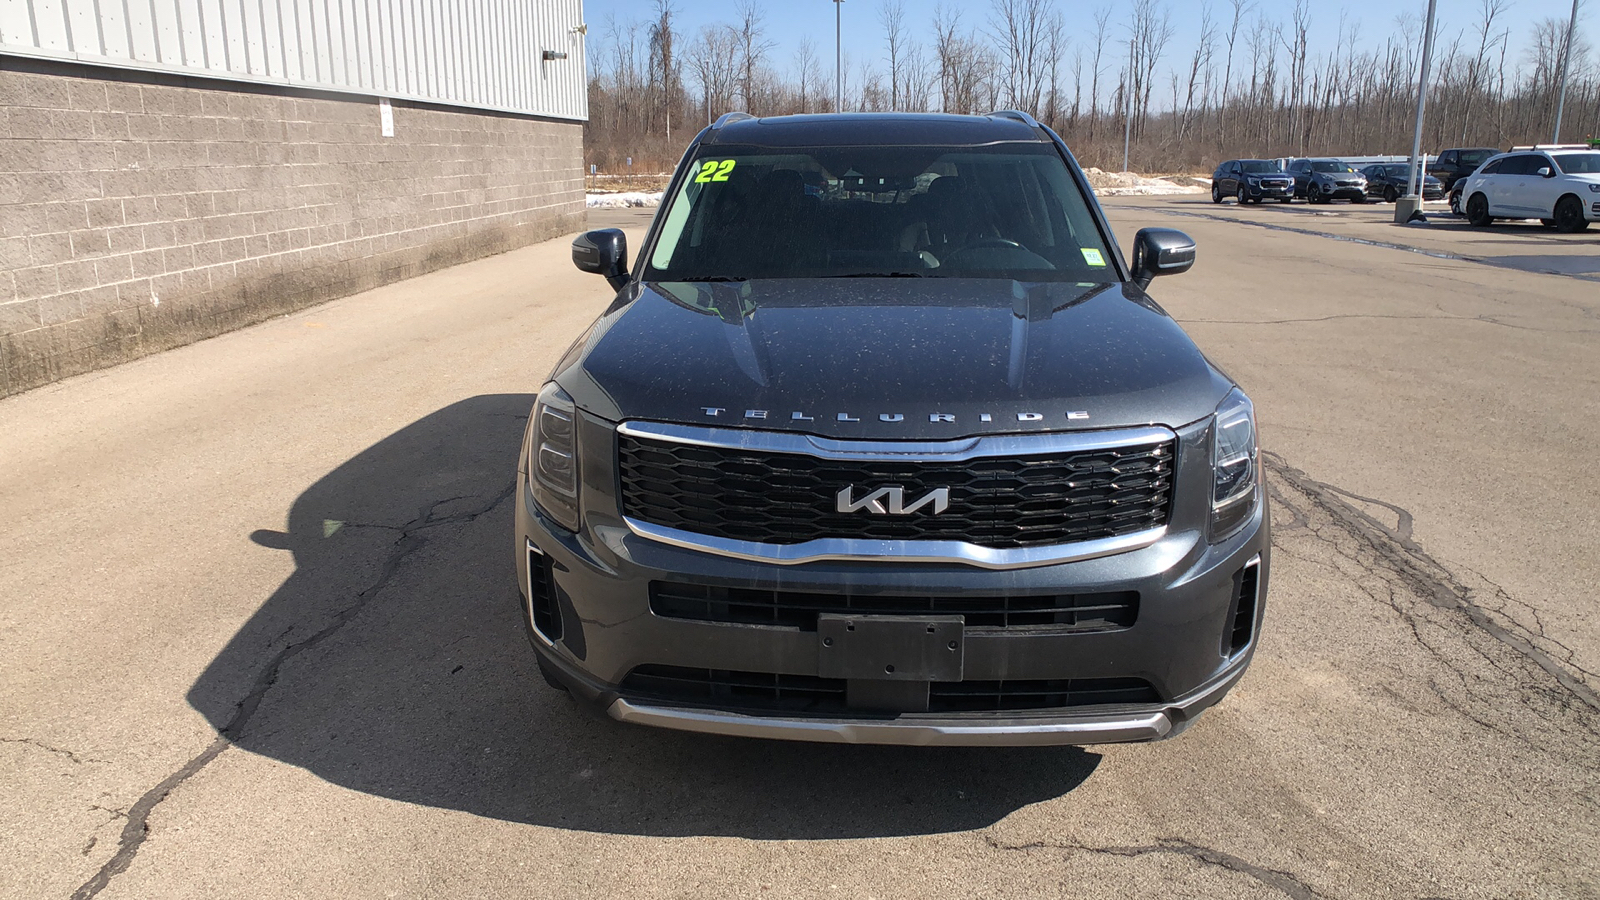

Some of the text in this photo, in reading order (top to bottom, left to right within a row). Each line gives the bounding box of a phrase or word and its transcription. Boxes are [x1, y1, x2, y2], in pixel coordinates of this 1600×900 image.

[695, 159, 736, 183] 22
[700, 406, 1090, 423] TELLURIDE
[837, 484, 950, 515] KIA
